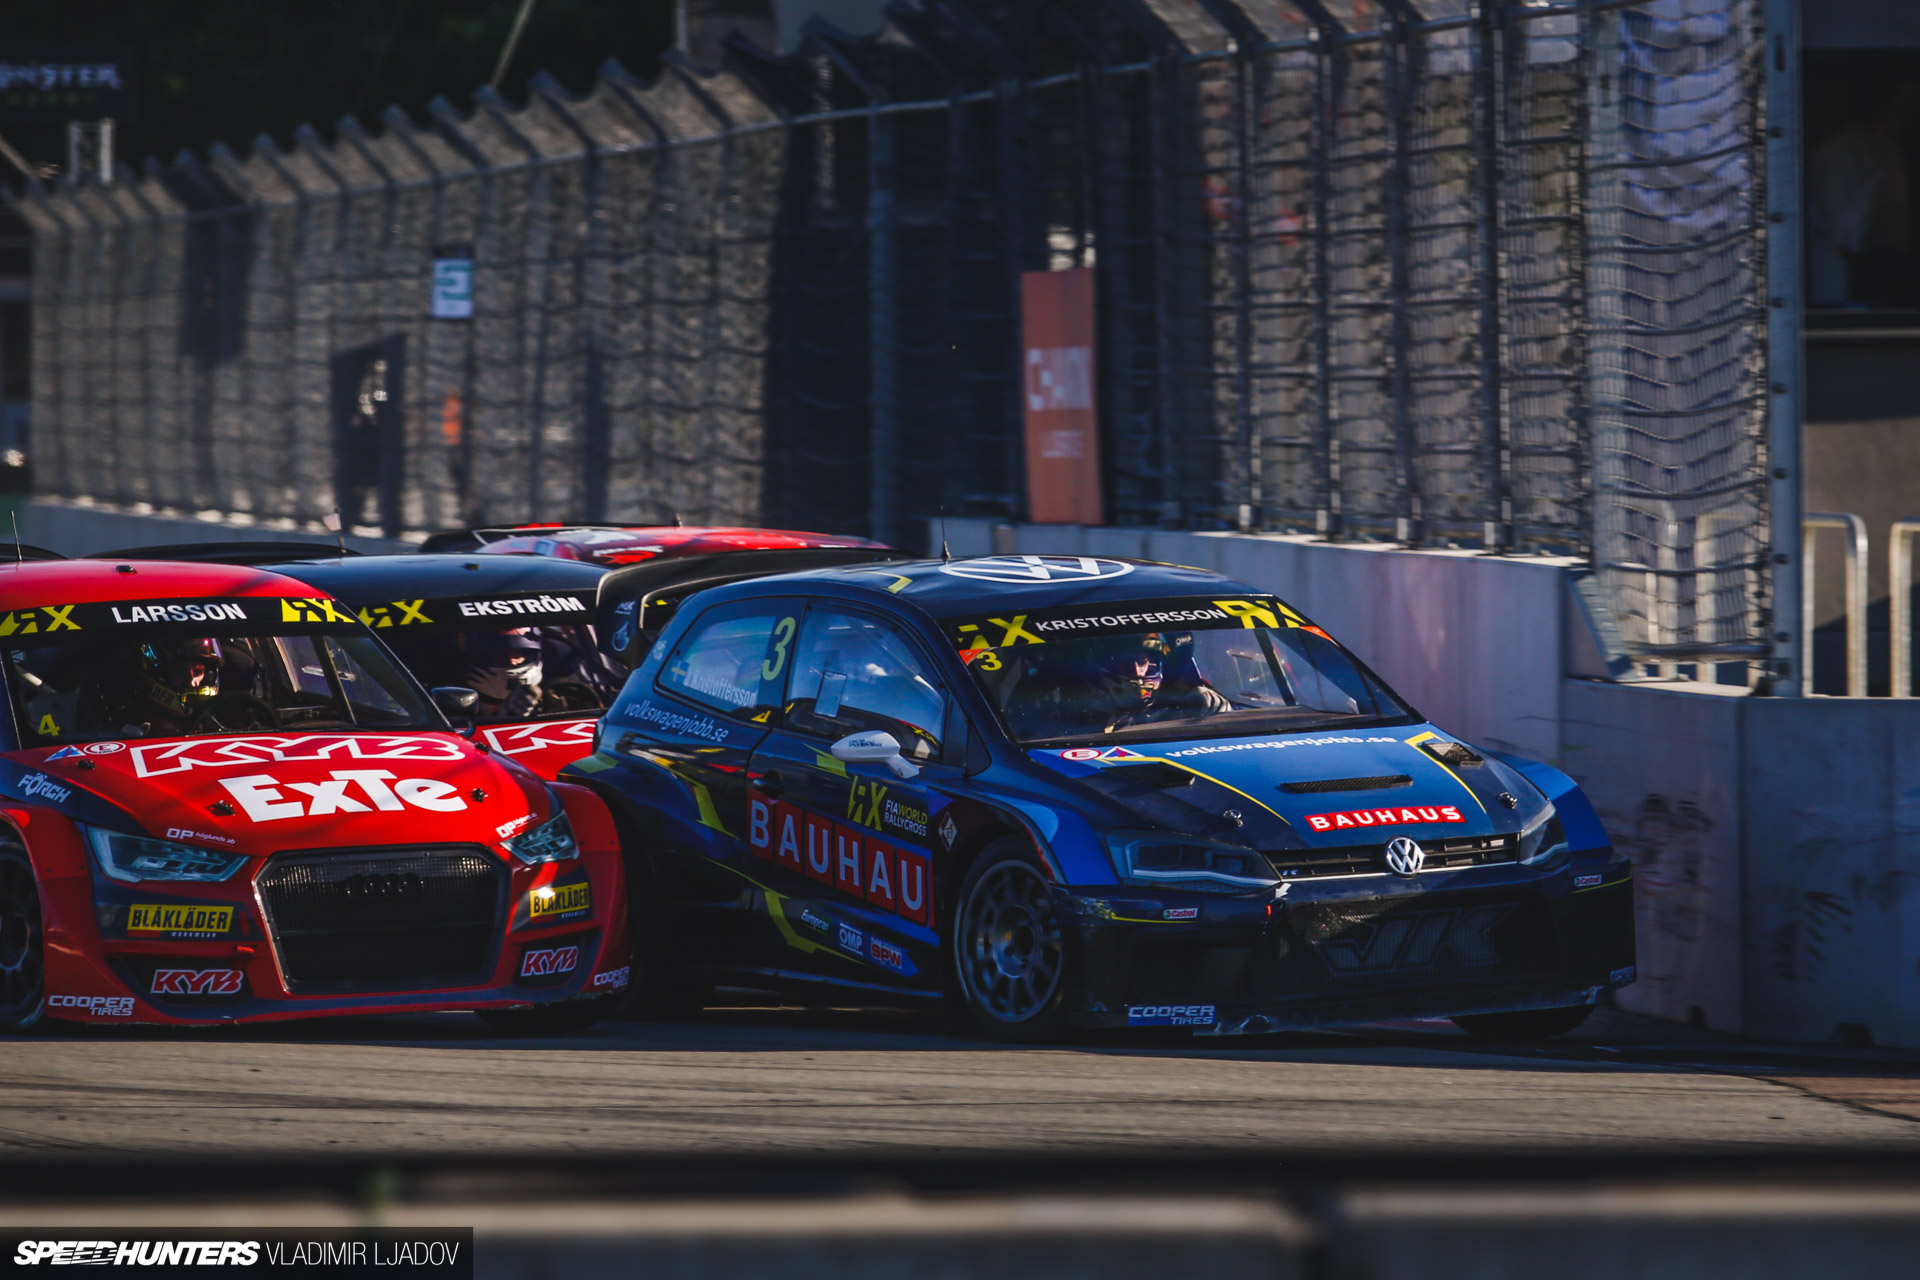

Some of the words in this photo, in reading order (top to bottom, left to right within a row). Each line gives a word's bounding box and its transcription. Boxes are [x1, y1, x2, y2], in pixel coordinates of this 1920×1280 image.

[111, 603, 247, 623] LARSSON
[458, 594, 587, 618] EKSTRÖM
[1035, 608, 1229, 632] KRISTOFFERSSON
[762, 616, 796, 681] 3
[976, 651, 1003, 671] 3
[692, 667, 759, 709] Kristoffersson
[38, 713, 61, 737] 4
[624, 699, 729, 742] volkswagenjobb.se
[130, 735, 466, 778] KYB
[1165, 736, 1398, 758] volkswagenjobb.se
[17, 773, 72, 804] FÖRCH
[218, 769, 468, 823] ExTe
[884, 811, 928, 837] RALLYCROSS
[1308, 805, 1462, 831] BAUHAUS
[131, 905, 230, 930] BLÅKLÄDER
[801, 909, 829, 932] Europcar
[1170, 909, 1196, 919] Castrol
[839, 928, 863, 950] OMP
[521, 945, 579, 977] KYB
[871, 942, 903, 970] SPW
[151, 968, 244, 994] KYB
[48, 994, 135, 1009] COOPER
[90, 1007, 133, 1016] TIRES
[1128, 1005, 1215, 1017] COOPER
[1170, 1017, 1213, 1025] TIRES
